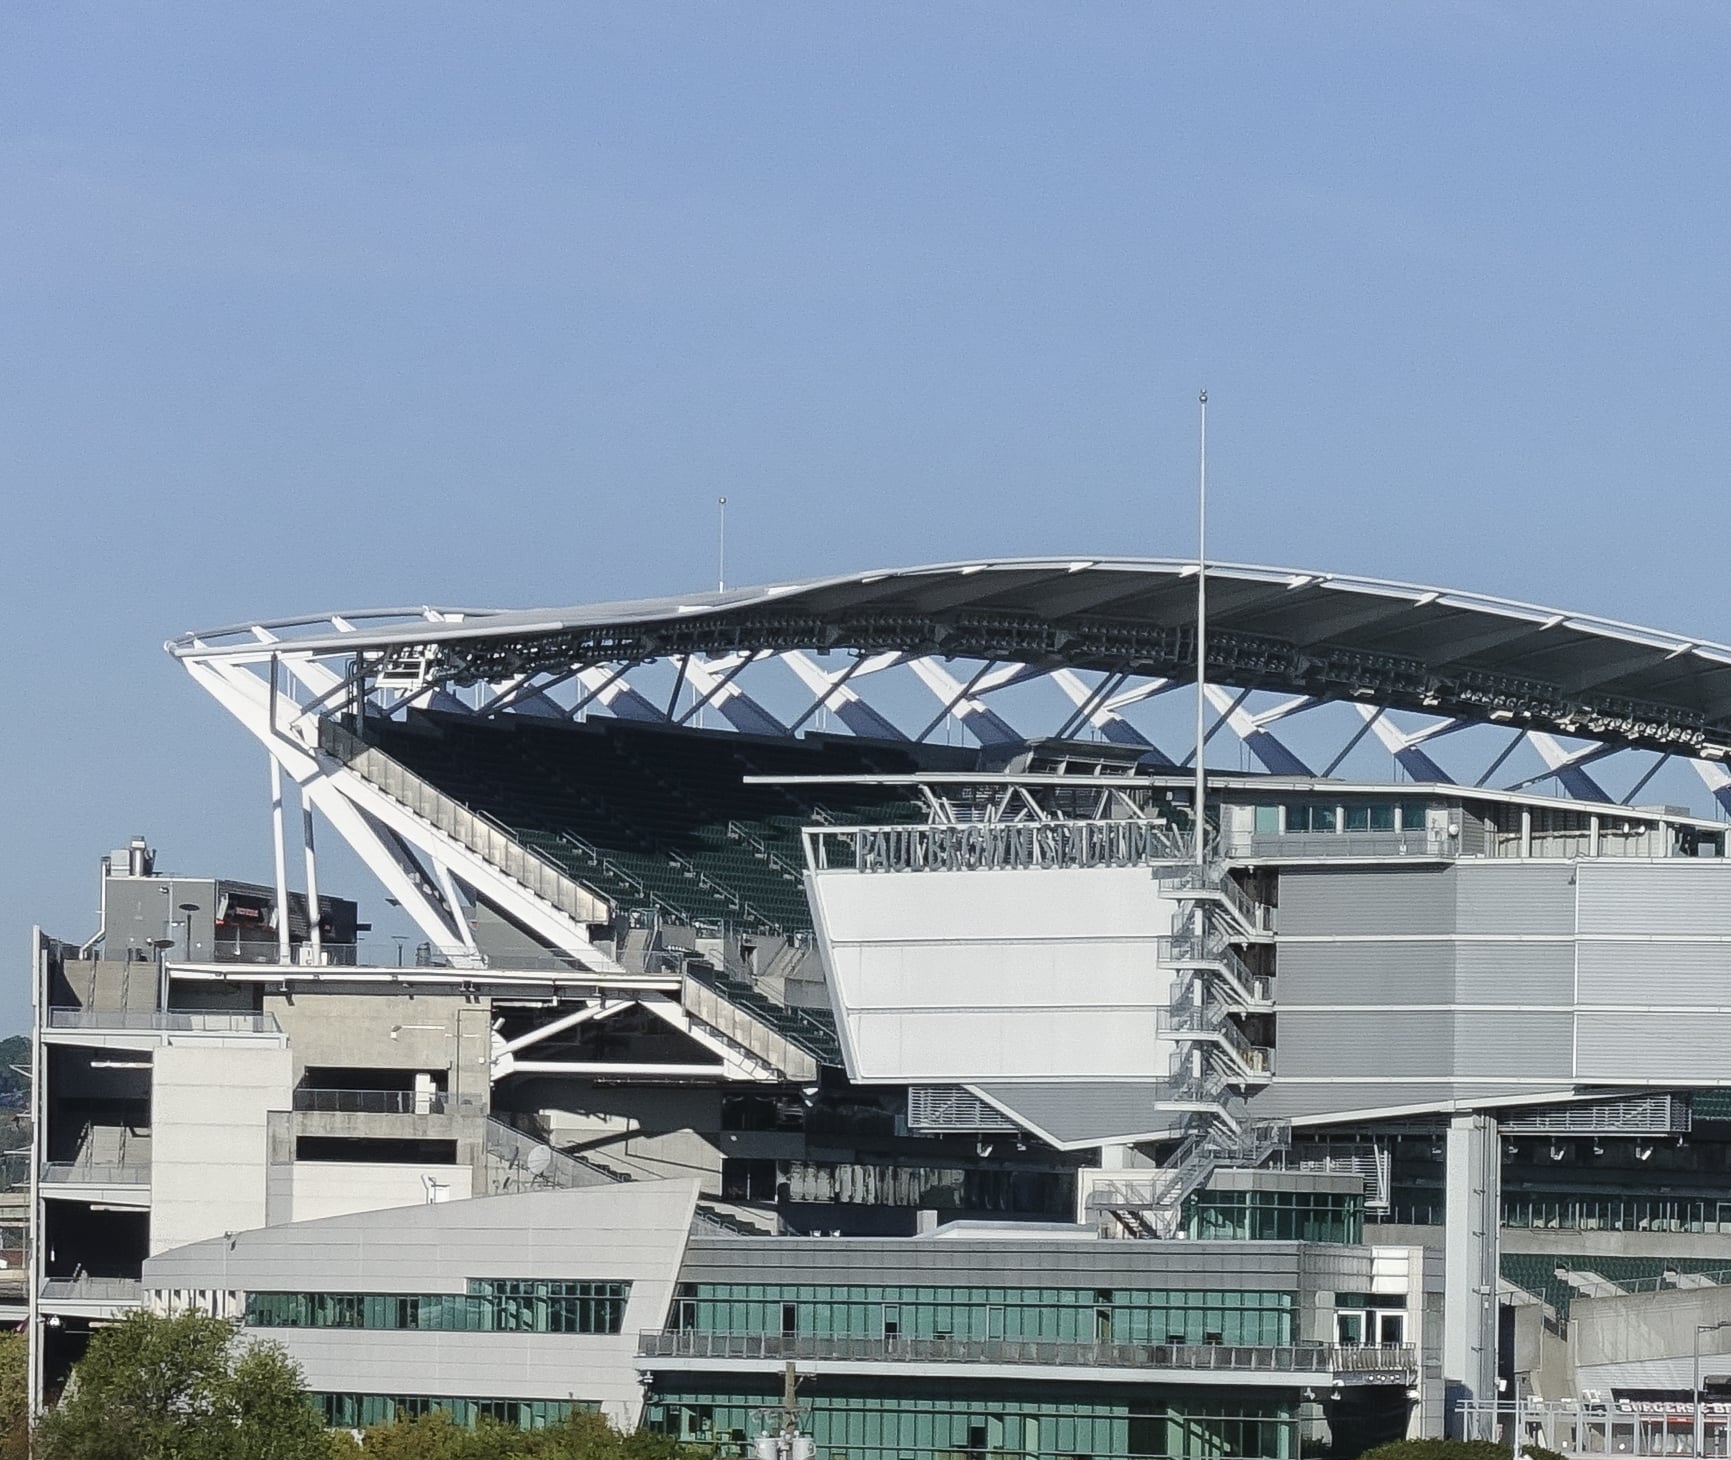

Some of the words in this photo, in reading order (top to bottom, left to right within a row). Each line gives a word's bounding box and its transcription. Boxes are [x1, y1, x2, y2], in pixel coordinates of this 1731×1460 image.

[859, 828, 924, 873] PAUL
[929, 826, 1031, 871] BROWN
[1038, 822, 1151, 868] STADIUM
